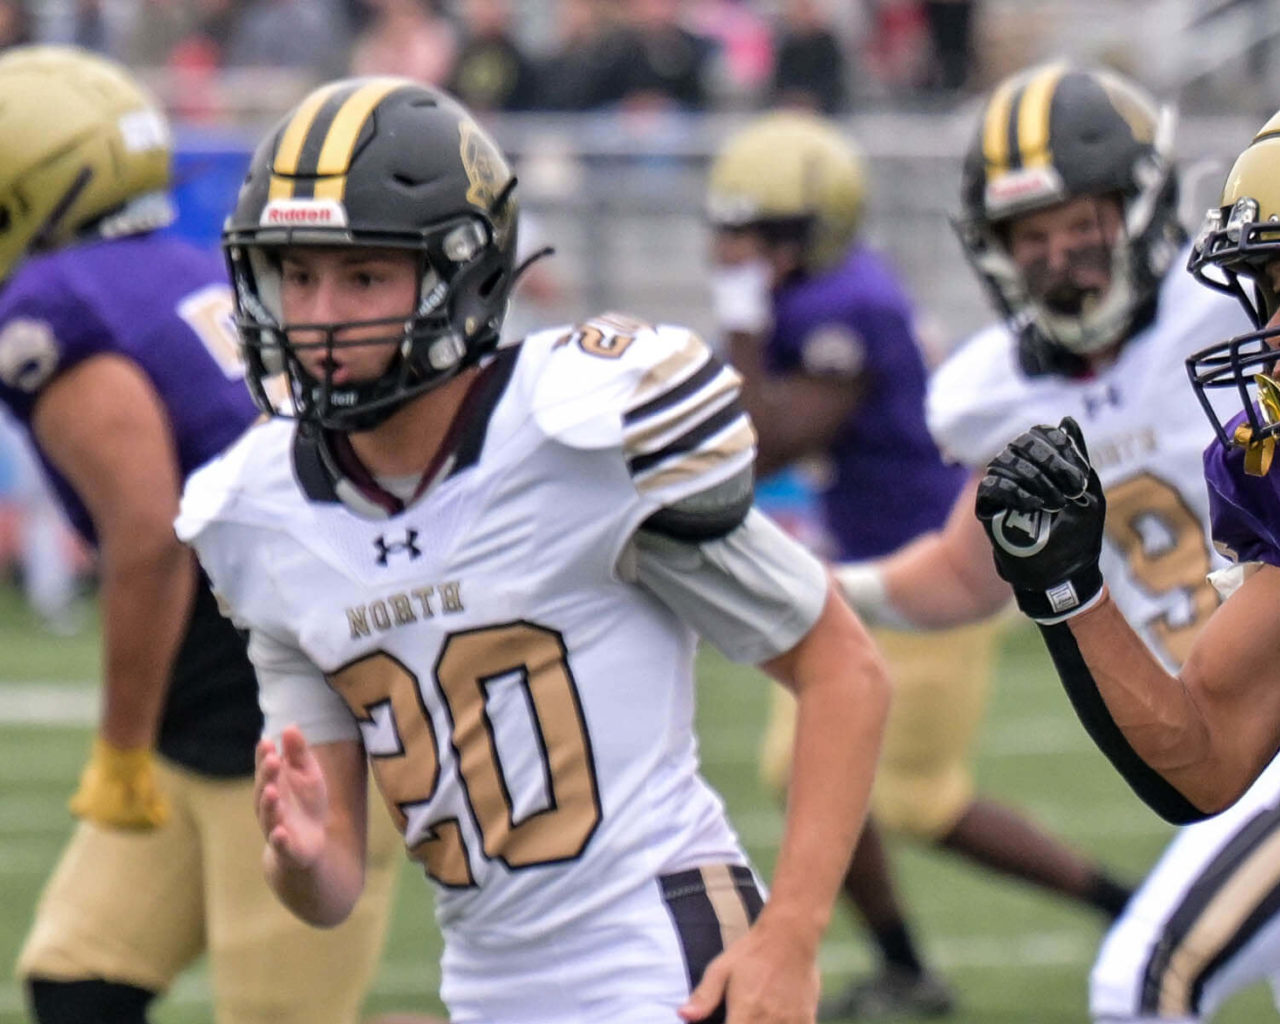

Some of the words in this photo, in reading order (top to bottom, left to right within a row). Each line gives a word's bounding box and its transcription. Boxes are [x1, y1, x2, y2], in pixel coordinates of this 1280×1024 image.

[268, 208, 332, 221] Riddell
[345, 581, 465, 640] NORTH
[324, 619, 603, 888] 20
